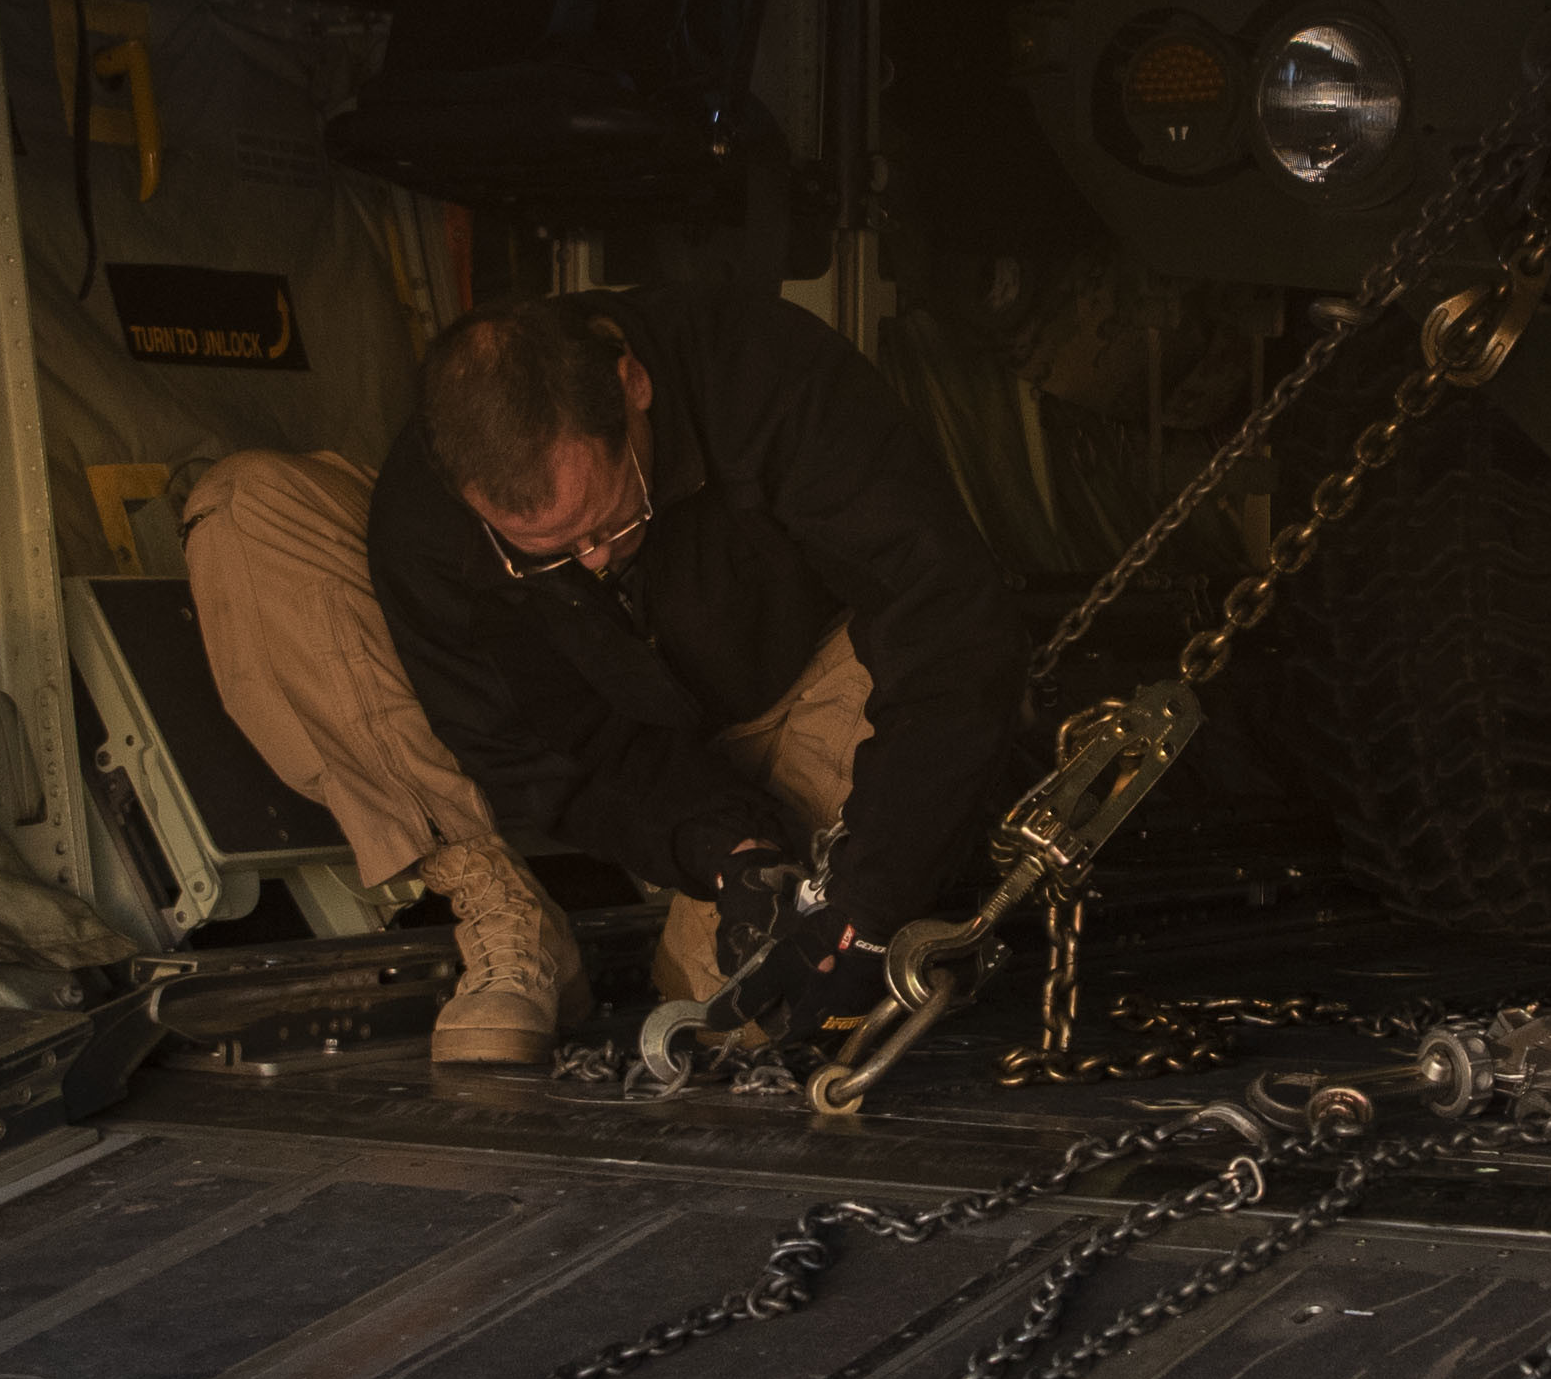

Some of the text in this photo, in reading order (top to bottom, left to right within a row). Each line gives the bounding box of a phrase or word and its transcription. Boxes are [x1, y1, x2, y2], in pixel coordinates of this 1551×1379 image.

[129, 325, 264, 358] TURN TO UNLOCK
